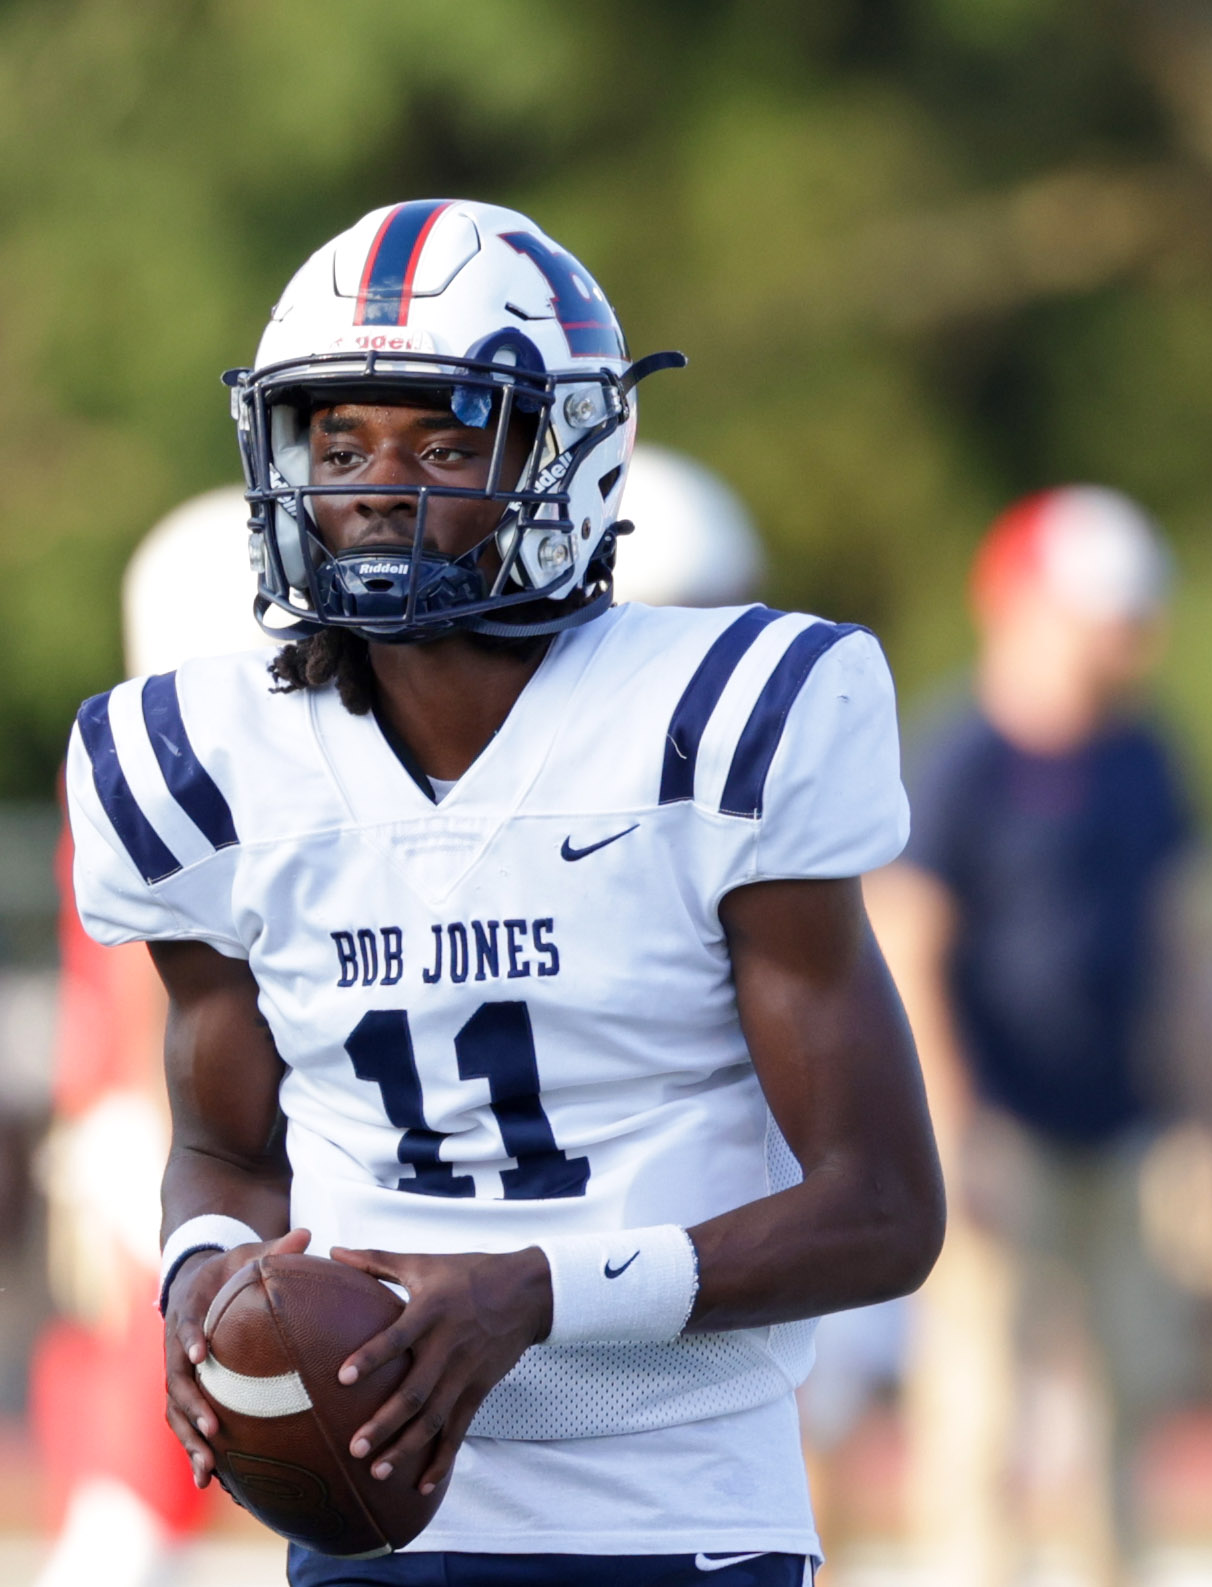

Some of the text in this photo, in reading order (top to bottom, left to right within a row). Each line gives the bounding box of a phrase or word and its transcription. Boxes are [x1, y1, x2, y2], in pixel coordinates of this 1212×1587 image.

[359, 563, 409, 575] Riddell
[330, 917, 560, 988] BOB JONES
[343, 1000, 591, 1200] 11
